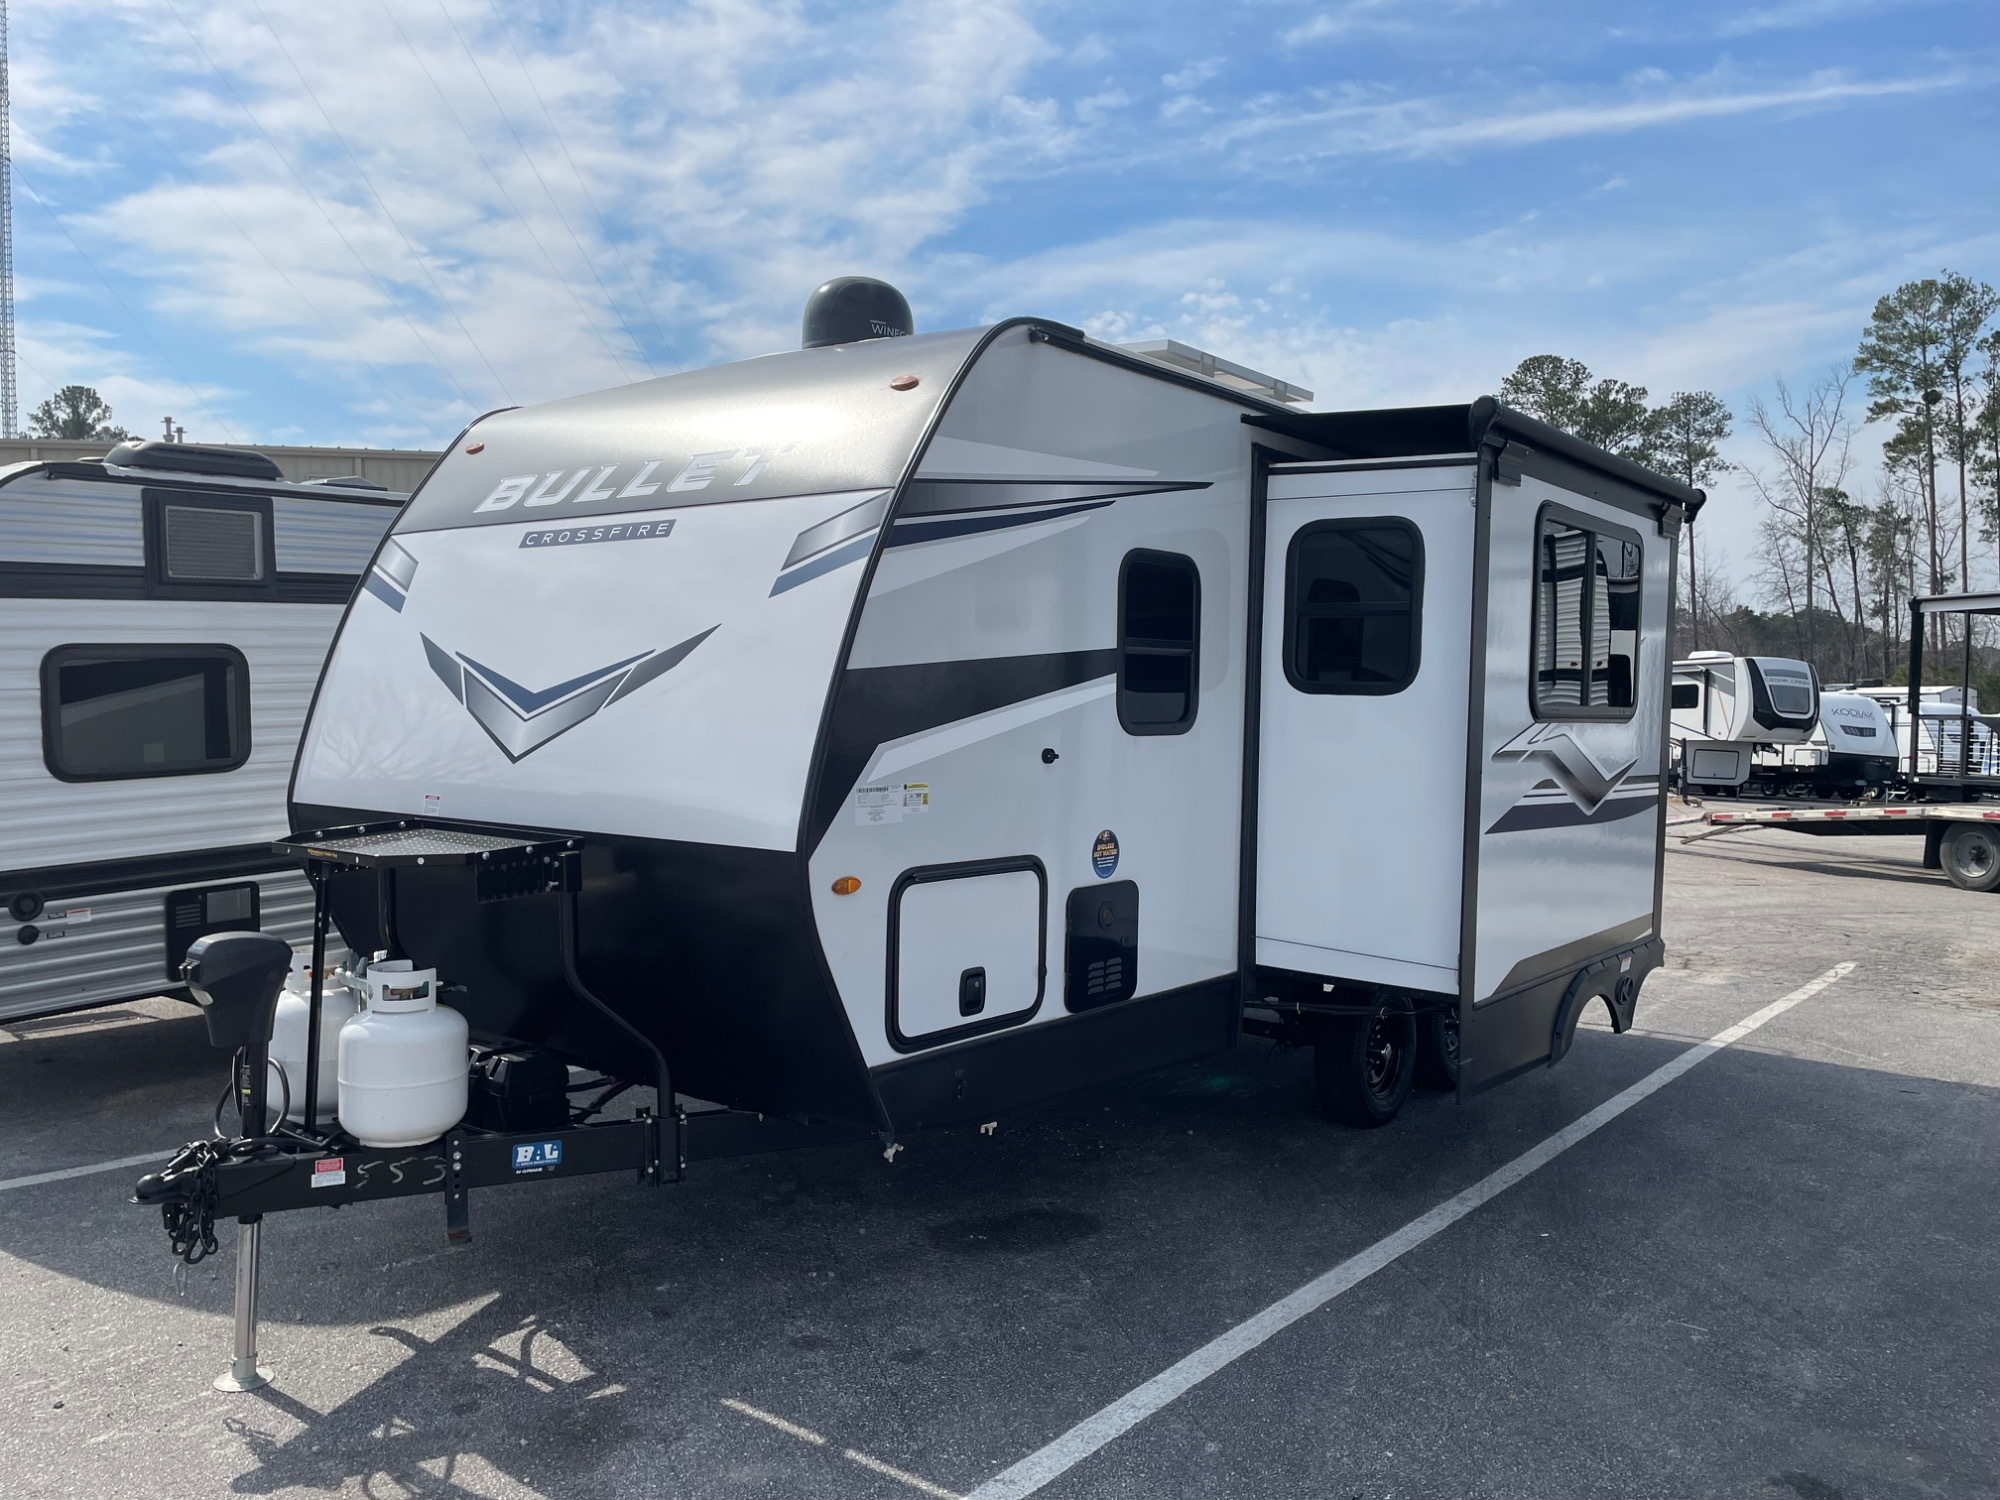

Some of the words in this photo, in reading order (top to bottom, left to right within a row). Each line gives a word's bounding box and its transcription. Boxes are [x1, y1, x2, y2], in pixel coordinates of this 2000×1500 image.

[473, 444, 797, 513] BULLET
[525, 522, 670, 546] CROSSFIRE
[1831, 707, 1876, 720] KODIAK
[516, 1143, 559, 1163] BAL
